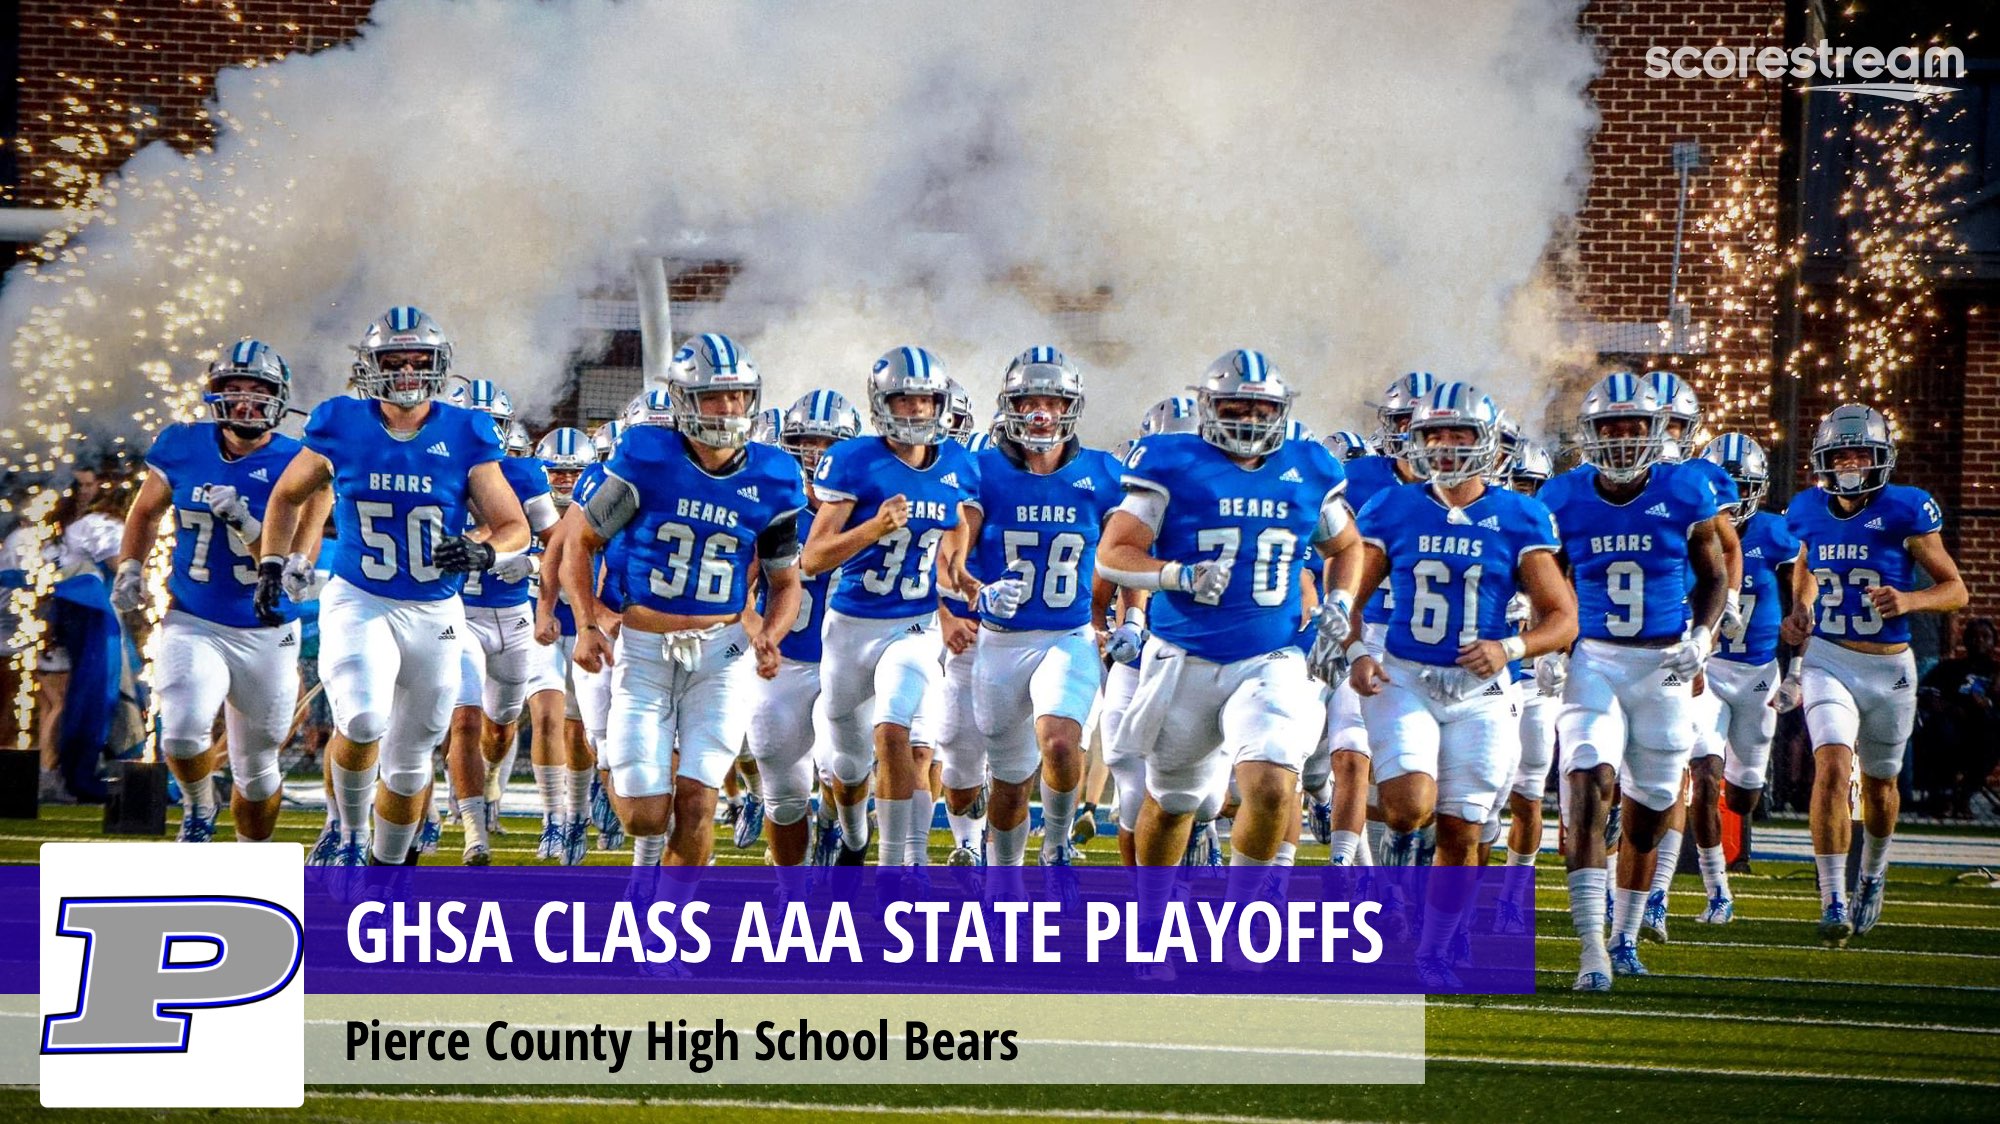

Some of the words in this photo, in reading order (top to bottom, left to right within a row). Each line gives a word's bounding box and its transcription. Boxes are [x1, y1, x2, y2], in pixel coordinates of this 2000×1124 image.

[370, 473, 432, 493] BEARS
[677, 498, 739, 528] BEARS
[905, 501, 946, 522] EARS
[1017, 505, 1077, 524] BEARS
[1219, 498, 1288, 519] BEARS
[356, 501, 444, 584] 50
[650, 521, 738, 603] 36
[862, 527, 944, 600] 33
[1195, 527, 1298, 607] 70
[1418, 535, 1482, 557] BEARS
[1591, 534, 1652, 554] BEARS
[1818, 544, 1868, 561] BEARS
[1004, 530, 1085, 608] 58
[1410, 560, 1482, 646] 61
[1606, 561, 1644, 637] 9
[1813, 567, 1883, 636] 23
